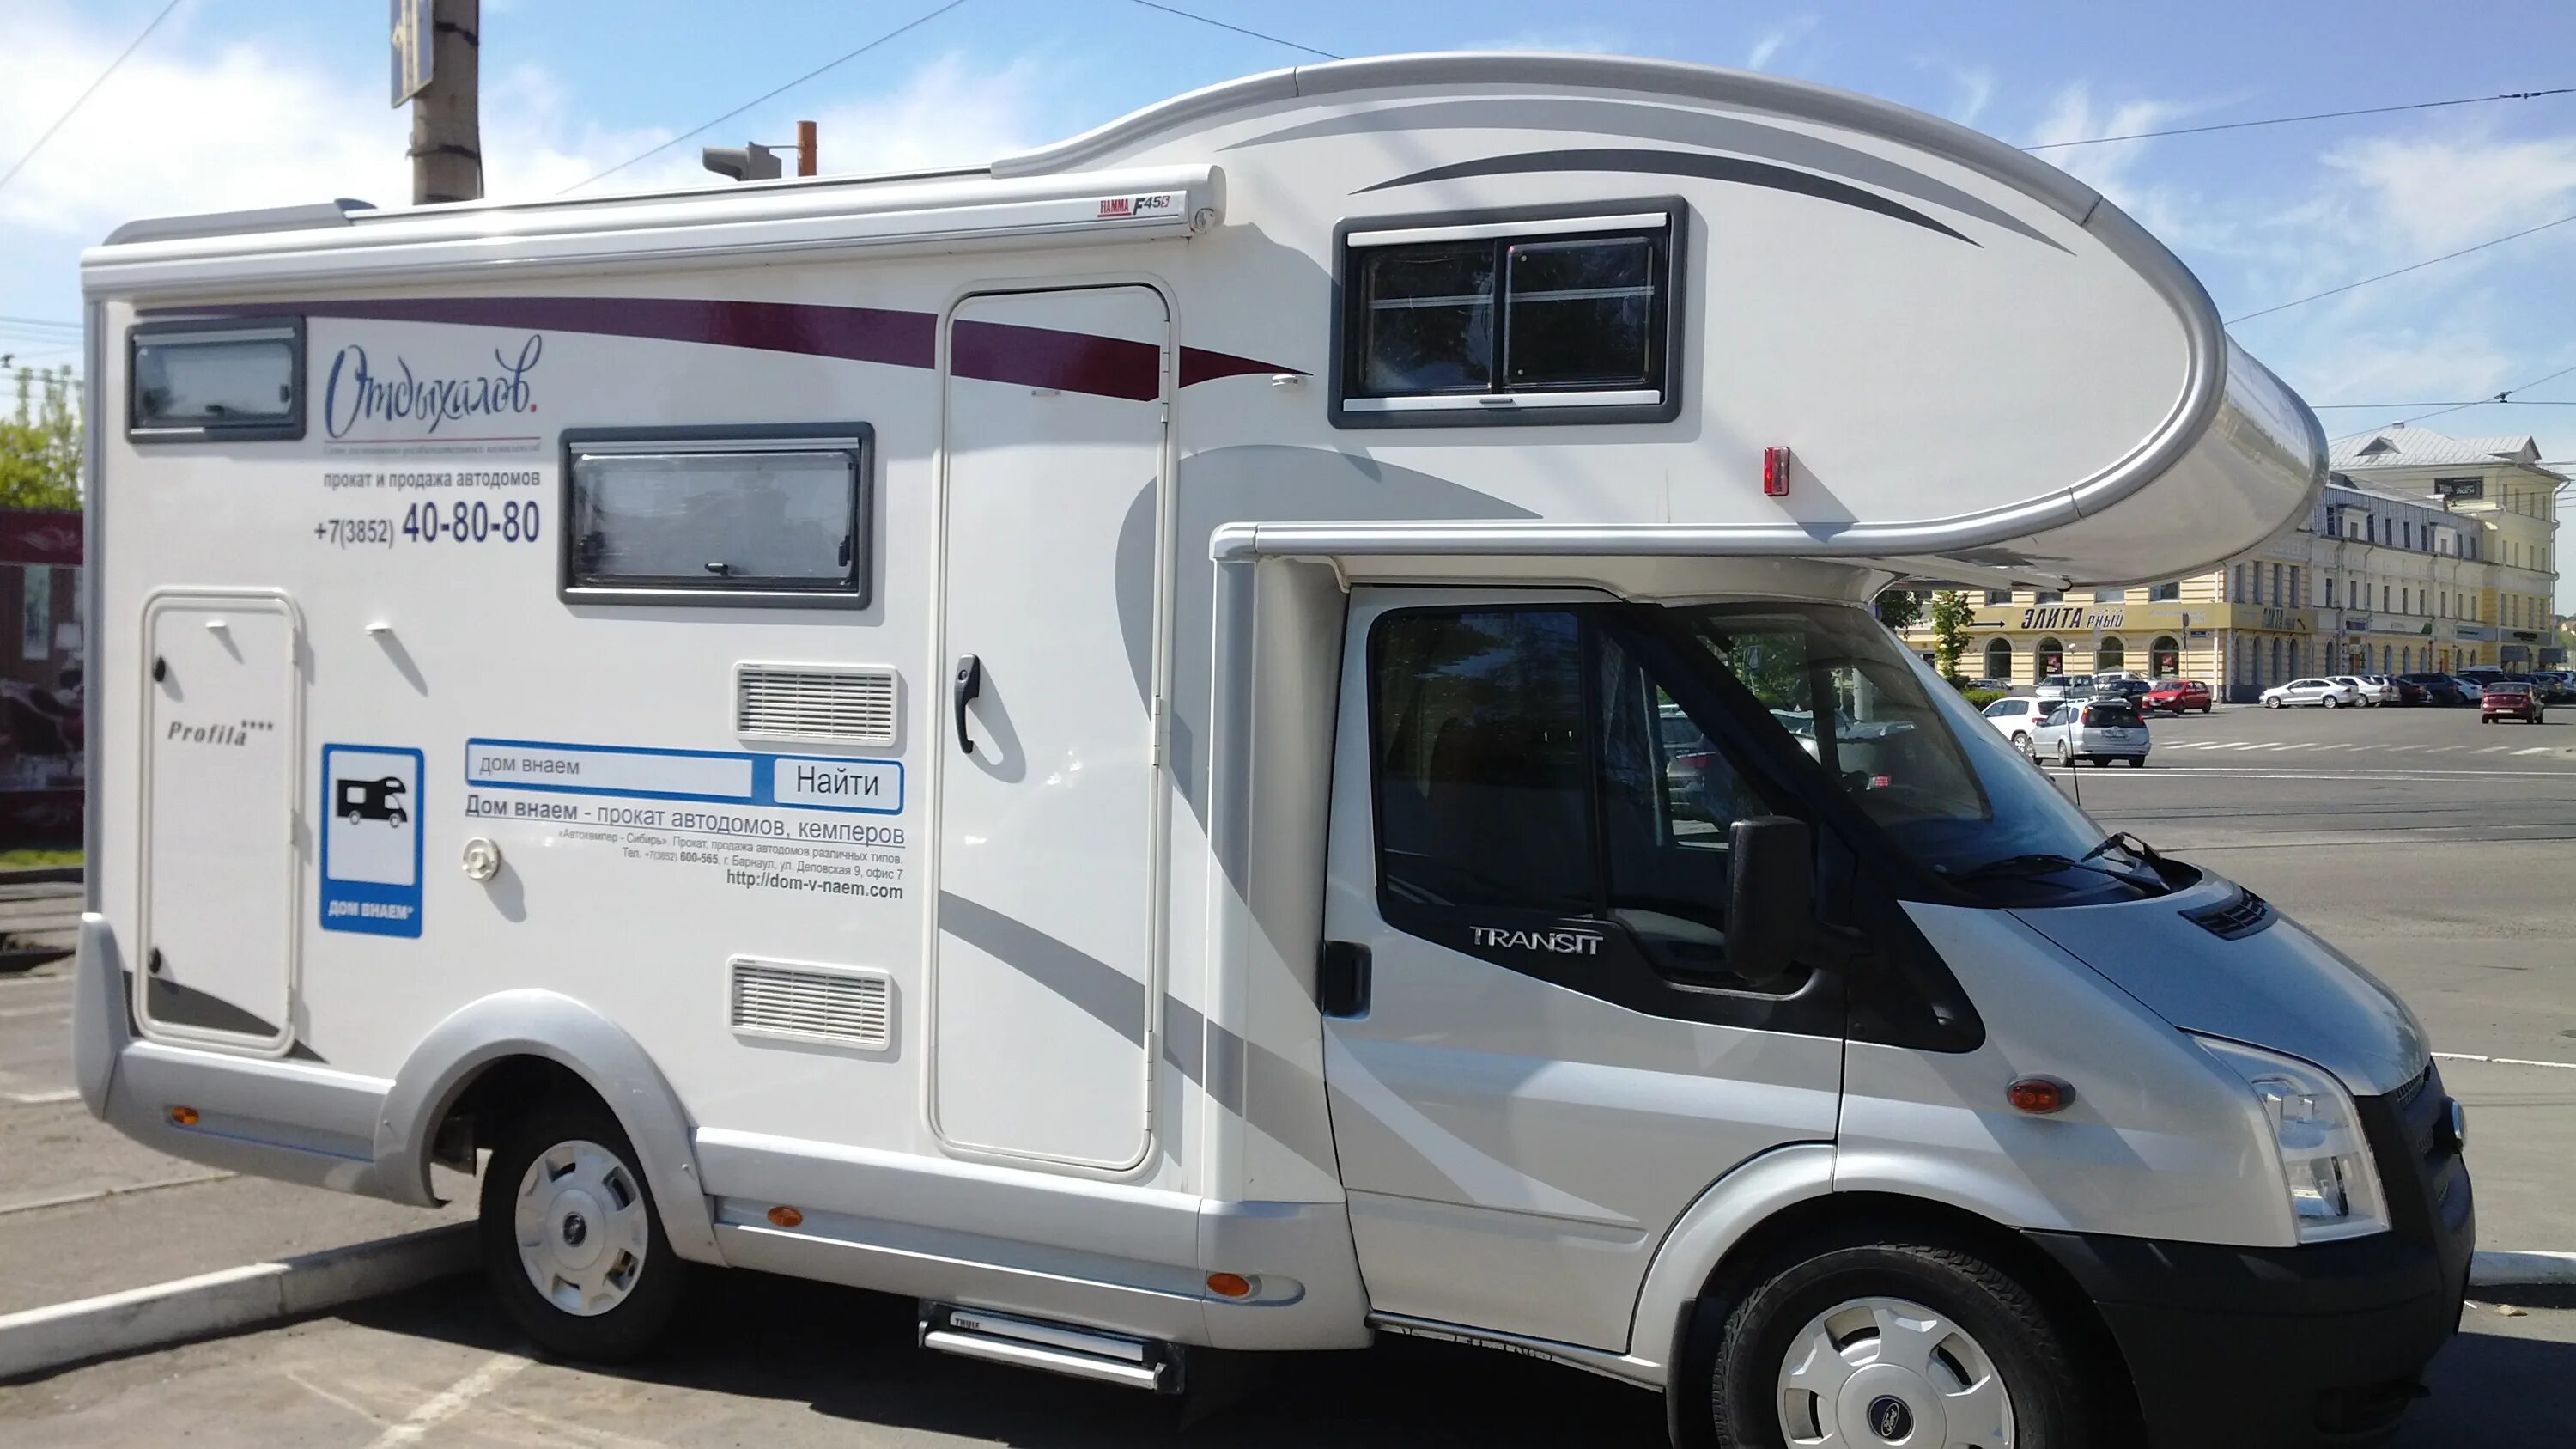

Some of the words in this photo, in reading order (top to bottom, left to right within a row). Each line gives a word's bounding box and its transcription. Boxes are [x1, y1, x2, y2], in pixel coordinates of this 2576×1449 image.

[1100, 198, 1129, 213] FIAMMA
[325, 334, 542, 439] Отдыхалов.
[323, 473, 372, 490] прокат
[376, 473, 385, 487] и
[389, 472, 452, 490] продажа
[456, 471, 540, 489] автодомов
[314, 519, 394, 550] +7(3852)
[402, 500, 540, 543] 40-80-80
[2020, 607, 2083, 629] ЭЛИТА
[479, 757, 515, 775] дом
[522, 759, 580, 775] внаем
[797, 764, 879, 795] Найти
[466, 795, 507, 817] Дом
[515, 802, 577, 820] внаем
[598, 807, 665, 826] прокат
[671, 812, 791, 839] автодомов,
[799, 821, 905, 847] кемперов
[711, 841, 754, 855] продажа
[756, 843, 810, 856] автодомов
[812, 847, 867, 861] различных
[797, 861, 851, 875] Деповская
[866, 868, 895, 880] офис
[896, 869, 903, 880] 7
[726, 869, 904, 900] http://dom-v-naem.com
[328, 899, 359, 917] ДОМ
[1469, 926, 1604, 955] TRANSIT
